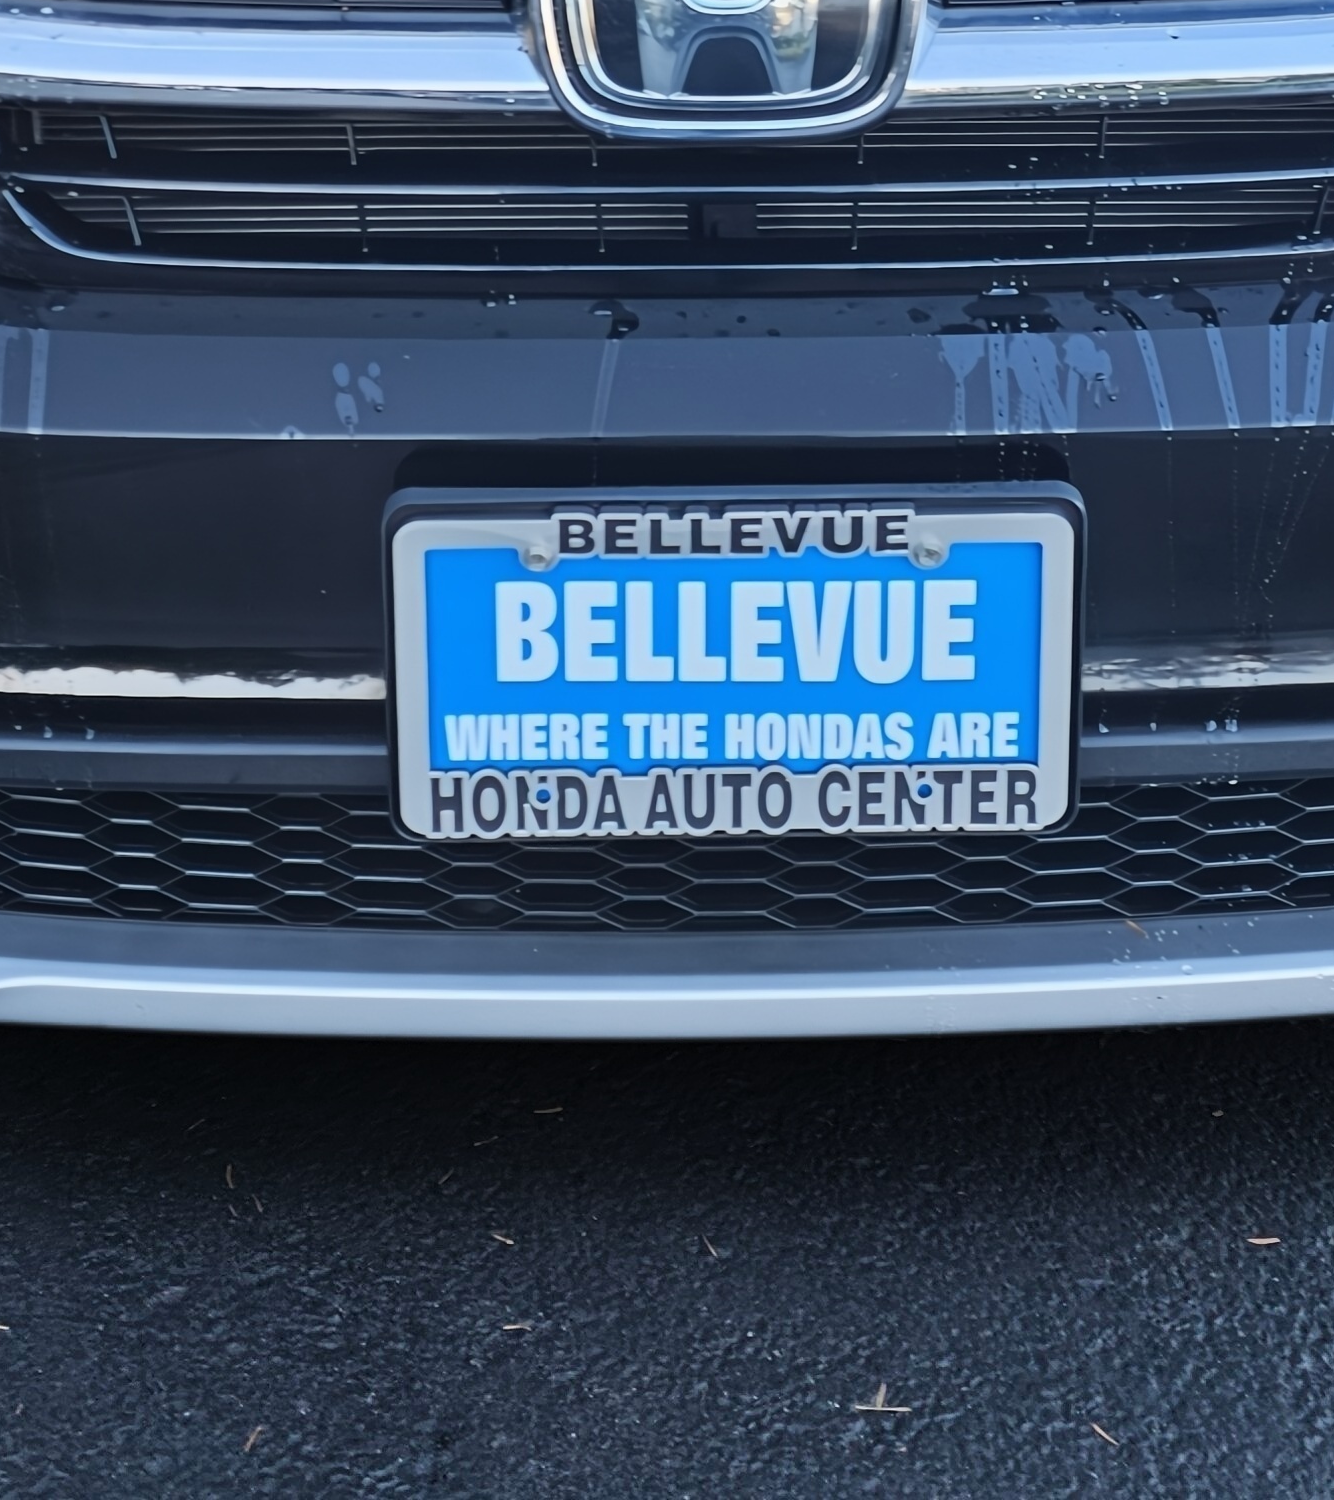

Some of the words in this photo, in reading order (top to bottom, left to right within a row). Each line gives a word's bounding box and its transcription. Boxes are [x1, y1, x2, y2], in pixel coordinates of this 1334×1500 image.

[558, 514, 909, 554] BELLEVUE
[494, 579, 977, 683] BELLEVUE
[444, 713, 608, 761] WHERE
[622, 713, 708, 759] THE
[724, 712, 913, 760] HONDAS
[927, 712, 1020, 757] ARE
[431, 775, 626, 833] HONDA
[645, 771, 792, 830] AUTO
[818, 769, 1037, 828] CENTER
